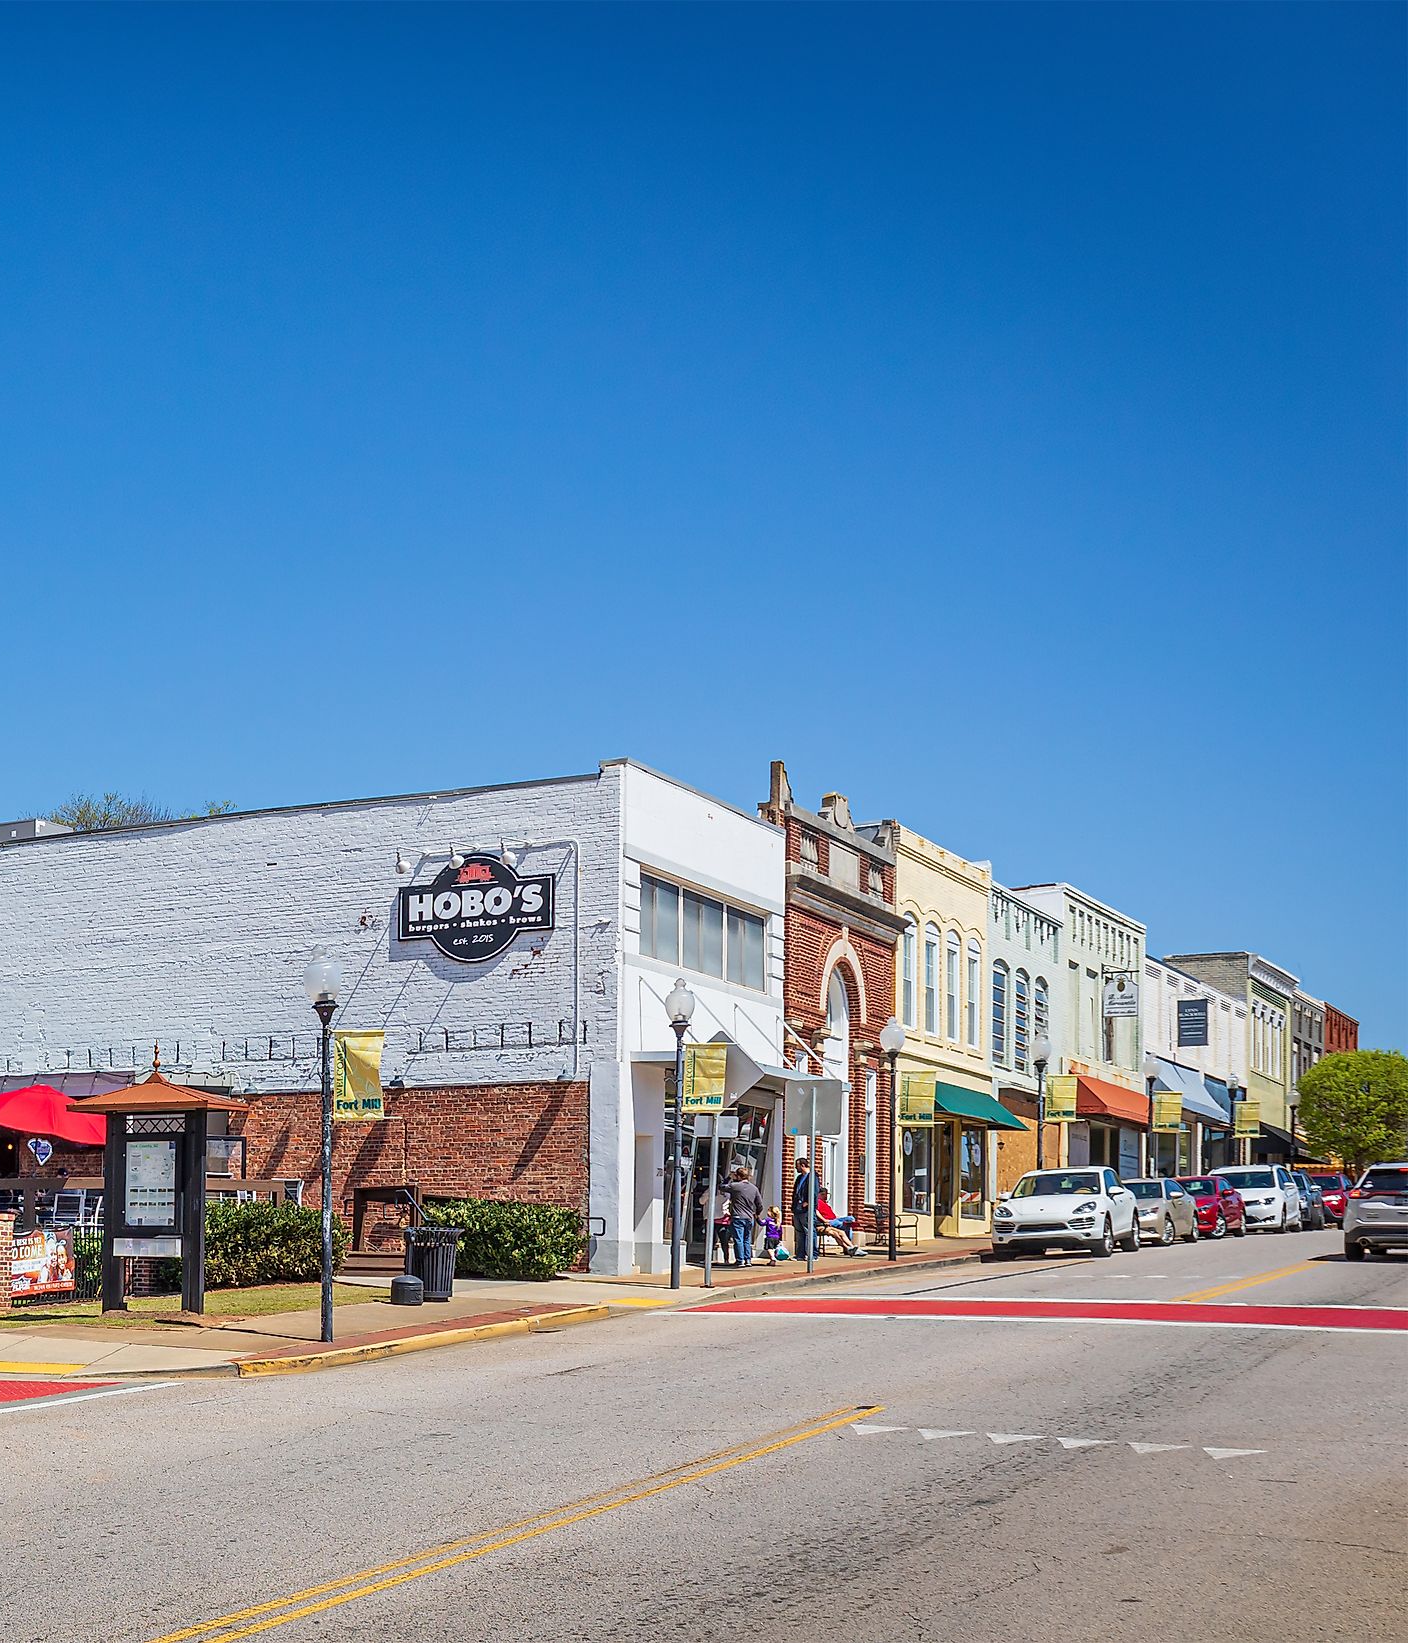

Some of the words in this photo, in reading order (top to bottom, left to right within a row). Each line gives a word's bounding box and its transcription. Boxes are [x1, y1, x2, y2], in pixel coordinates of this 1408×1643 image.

[408, 884, 544, 922] HOBO'S
[408, 923, 450, 933] burgers
[460, 917, 498, 928] shakes
[508, 915, 543, 924] brews
[471, 933, 495, 944] 2015
[336, 1099, 359, 1111] Fort
[361, 1098, 382, 1109] Mill
[685, 1096, 703, 1105] Fort
[706, 1096, 722, 1105] Mill
[12, 1247, 18, 1259] O
[19, 1244, 43, 1259] COME
